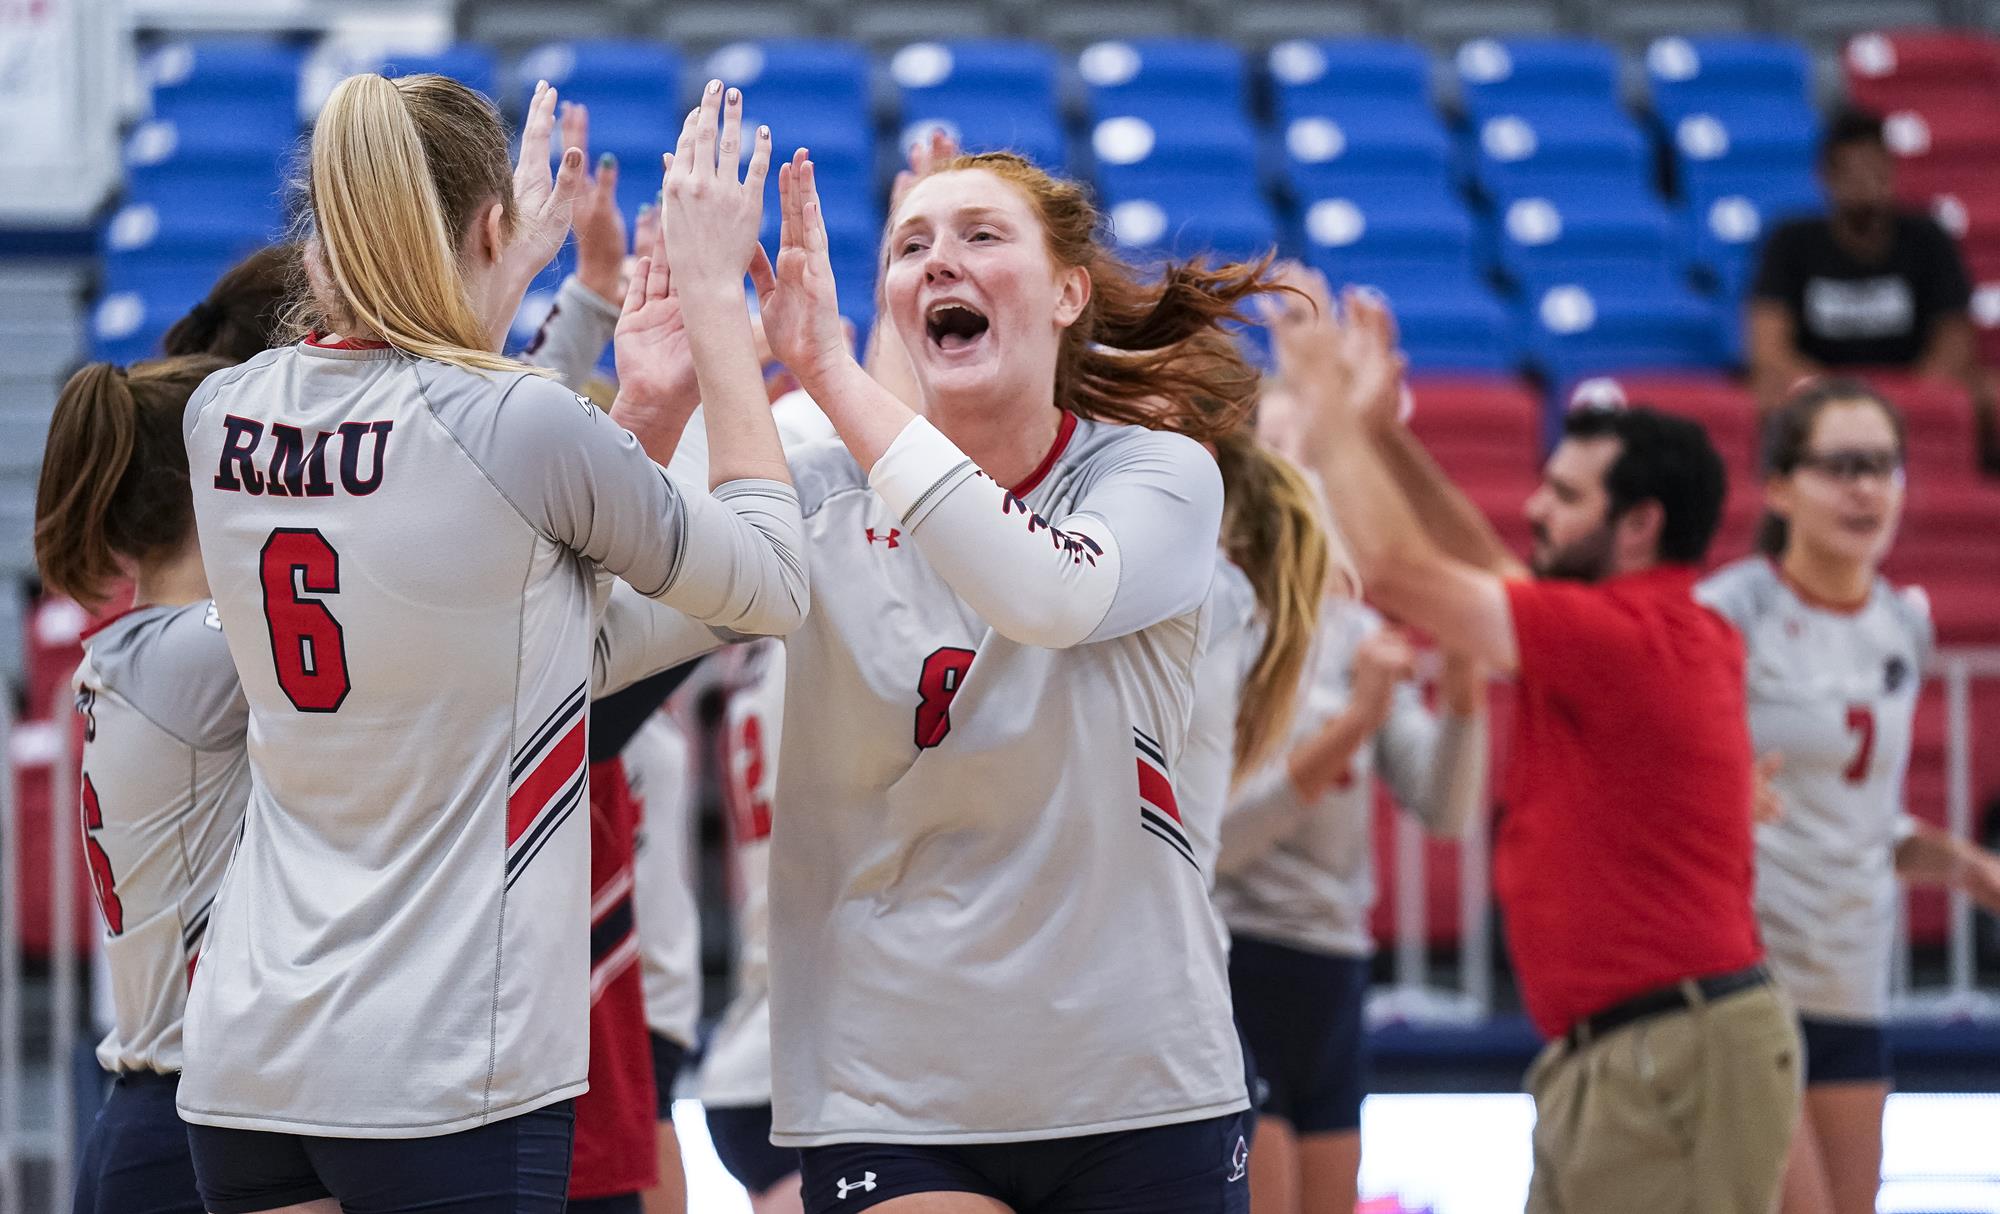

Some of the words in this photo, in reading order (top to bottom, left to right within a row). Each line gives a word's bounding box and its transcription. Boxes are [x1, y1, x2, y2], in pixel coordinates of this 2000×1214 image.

[214, 413, 394, 497] RMU
[259, 527, 351, 713] 6
[914, 646, 977, 752] 8
[1842, 702, 1877, 787] 7
